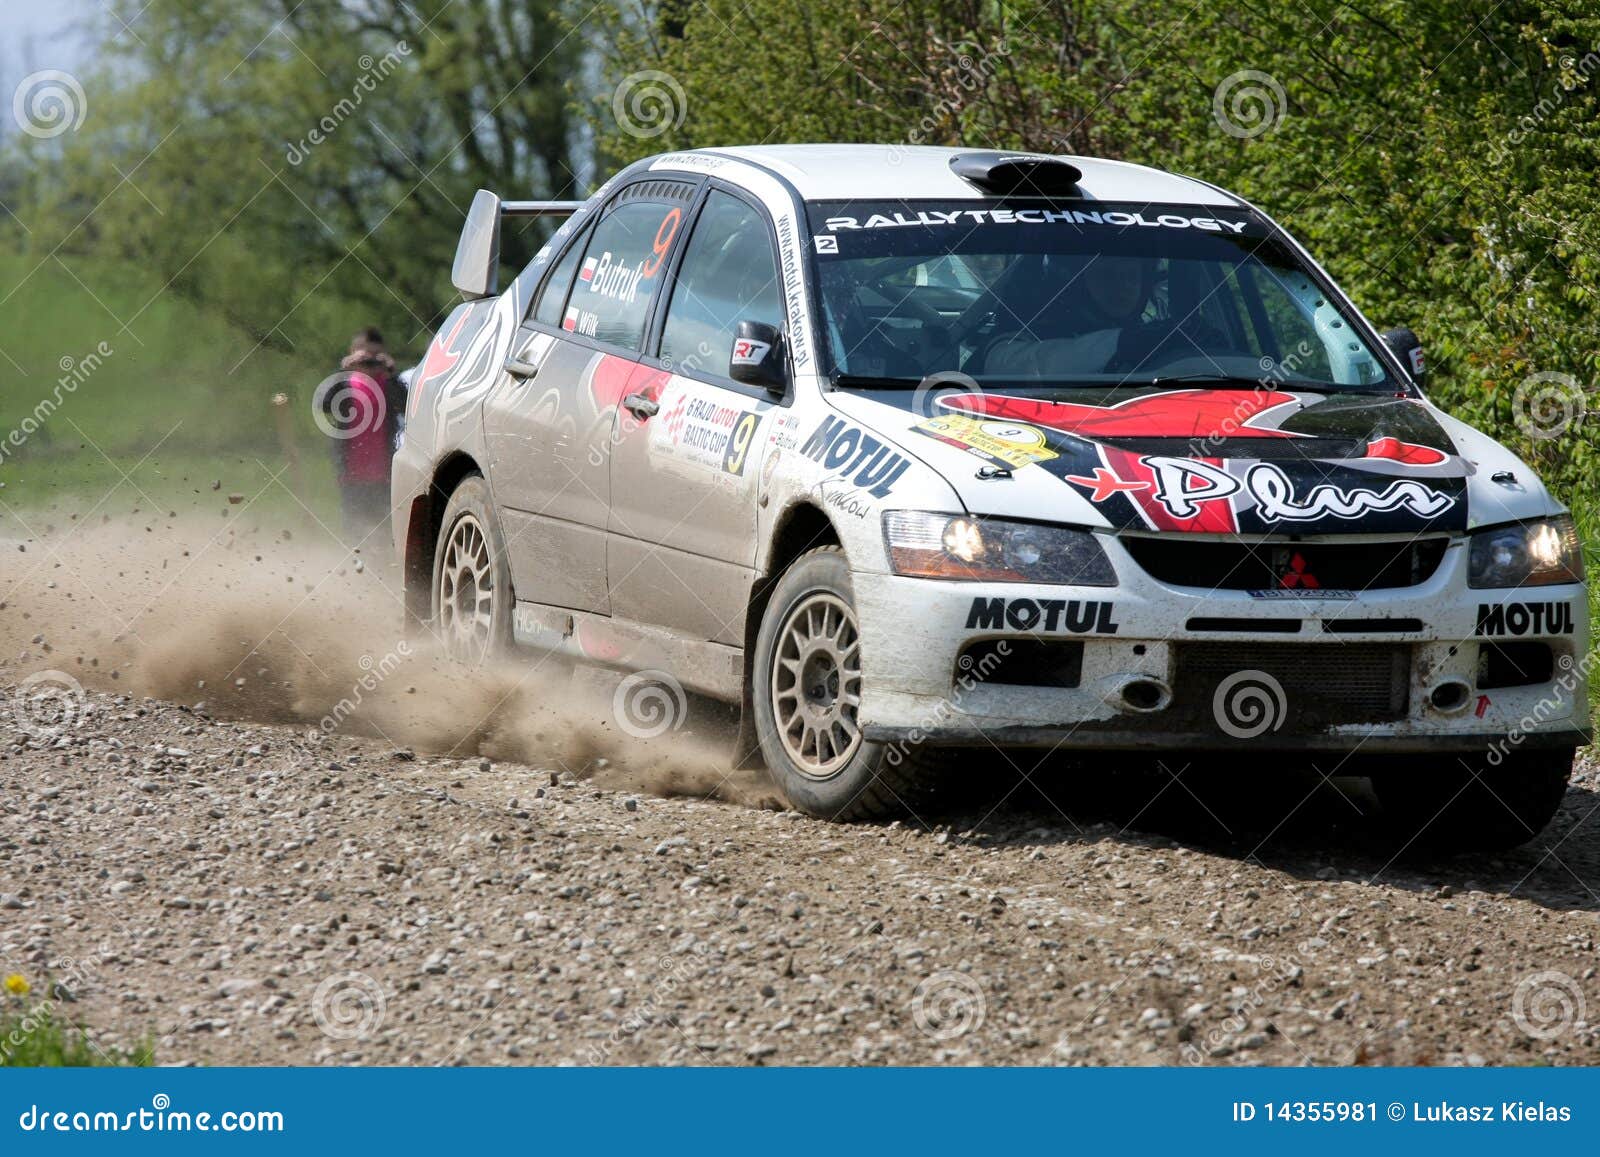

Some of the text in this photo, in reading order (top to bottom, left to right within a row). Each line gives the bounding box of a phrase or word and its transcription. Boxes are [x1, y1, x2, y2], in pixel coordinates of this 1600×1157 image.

[826, 209, 1247, 233] RALLYTECHNOLOGY
[642, 207, 682, 279] 9
[818, 238, 835, 251] 2
[590, 251, 644, 303] Butruk
[777, 214, 810, 368] www.motul.krakow.pl
[579, 311, 599, 337] Wilk
[735, 342, 763, 357] RT
[693, 400, 715, 422] RAJD
[712, 406, 739, 428] LOTOS
[683, 424, 728, 454] BALTIC CUP
[728, 414, 755, 473] 9
[800, 414, 912, 499] MOTUL
[1140, 454, 1455, 523] Plus
[965, 597, 1119, 633] MOTUL
[1475, 602, 1575, 635] MOTUL
